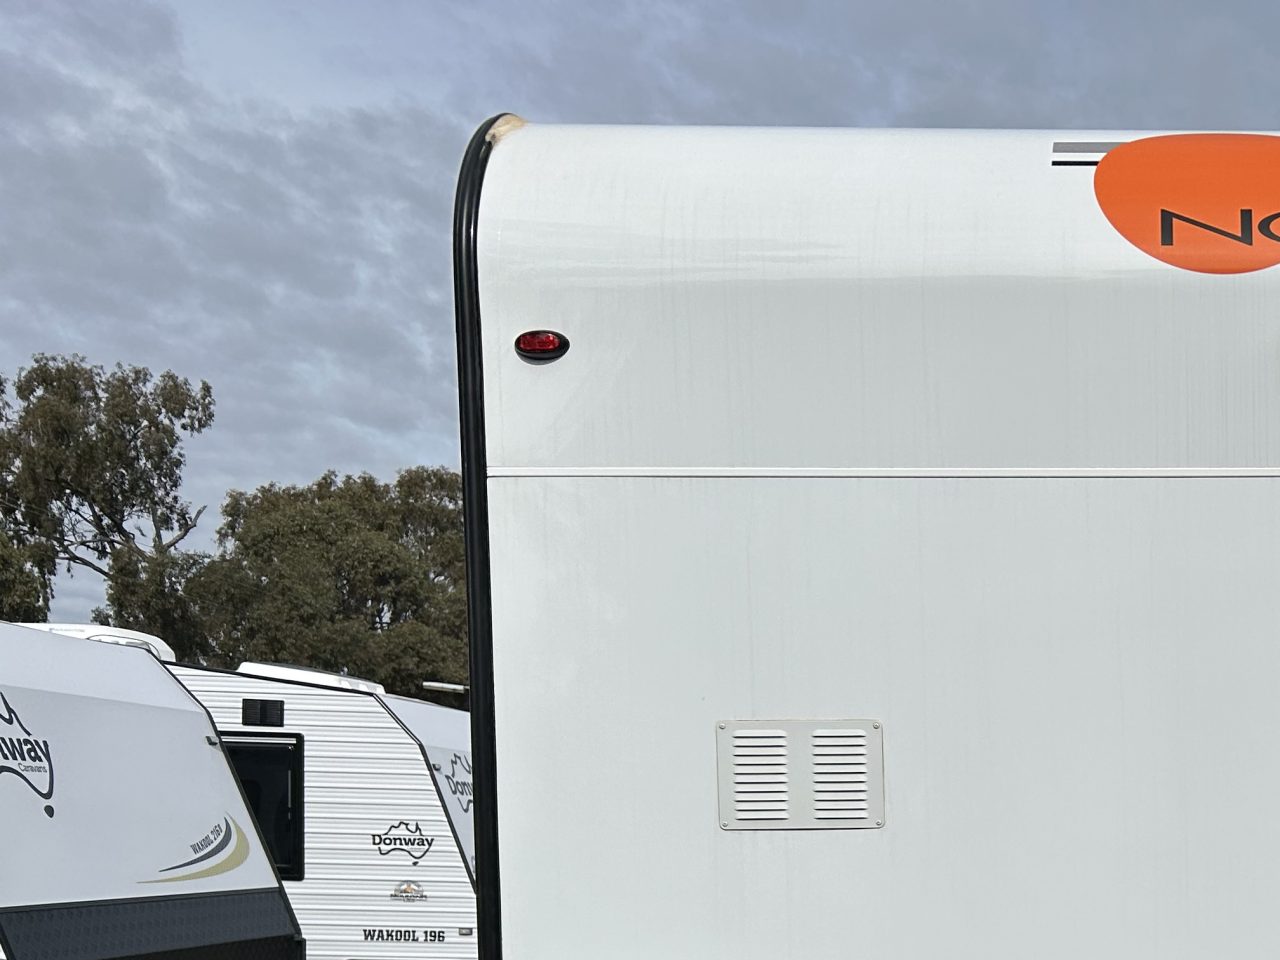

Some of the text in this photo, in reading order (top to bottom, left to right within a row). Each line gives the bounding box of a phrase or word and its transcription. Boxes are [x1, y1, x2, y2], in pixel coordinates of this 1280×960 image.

[444, 774, 473, 796] Don
[371, 834, 434, 848] Donway
[362, 928, 445, 942] WAKOOL 196
